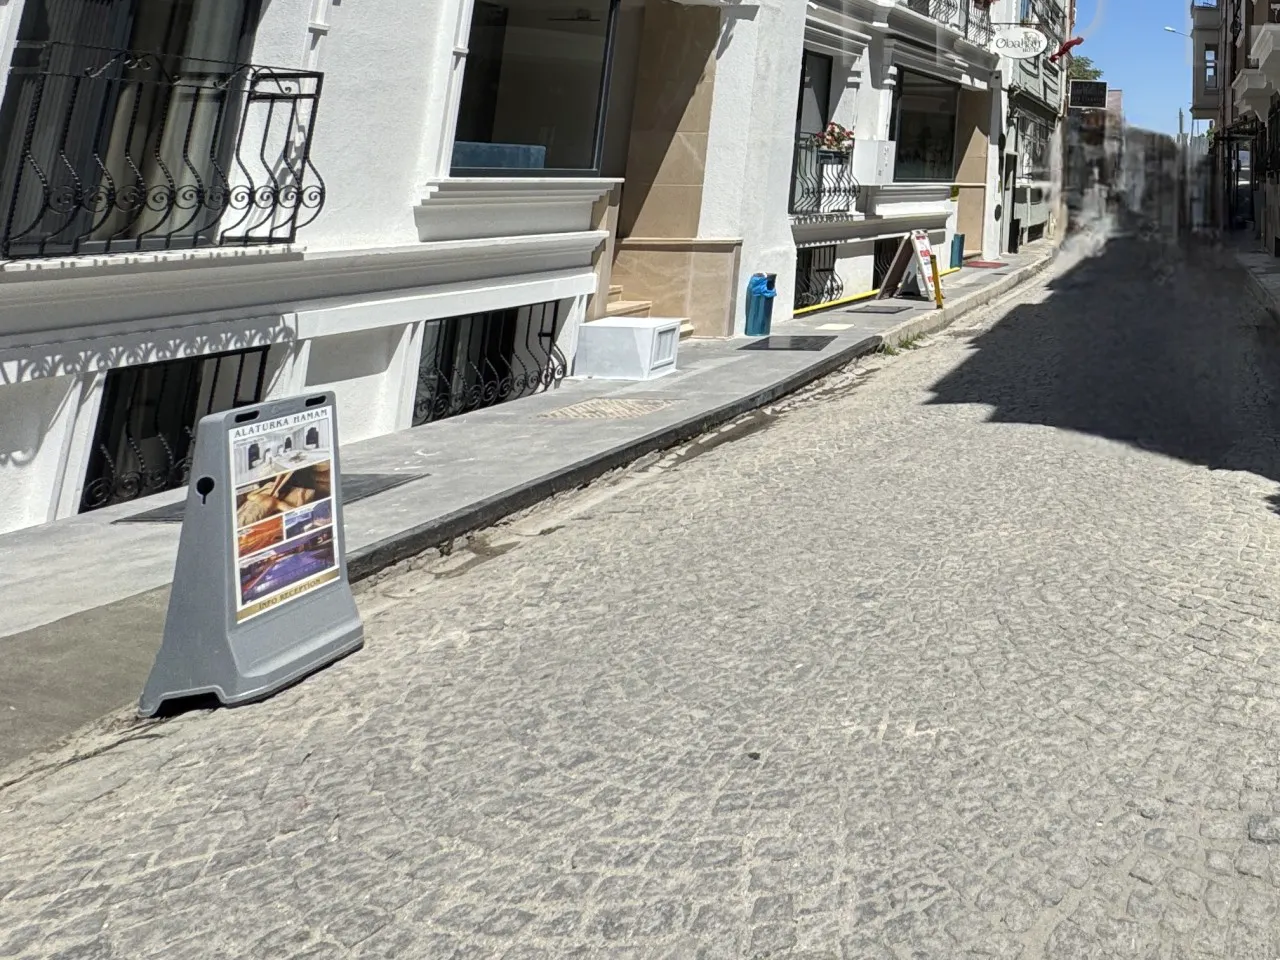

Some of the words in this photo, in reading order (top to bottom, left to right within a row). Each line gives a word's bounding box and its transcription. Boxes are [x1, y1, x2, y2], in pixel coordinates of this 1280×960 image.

[234, 417, 289, 439] ALATURKA
[293, 408, 328, 424] HAMAM
[259, 596, 278, 609] INFO
[279, 578, 321, 601] RECEPTION
